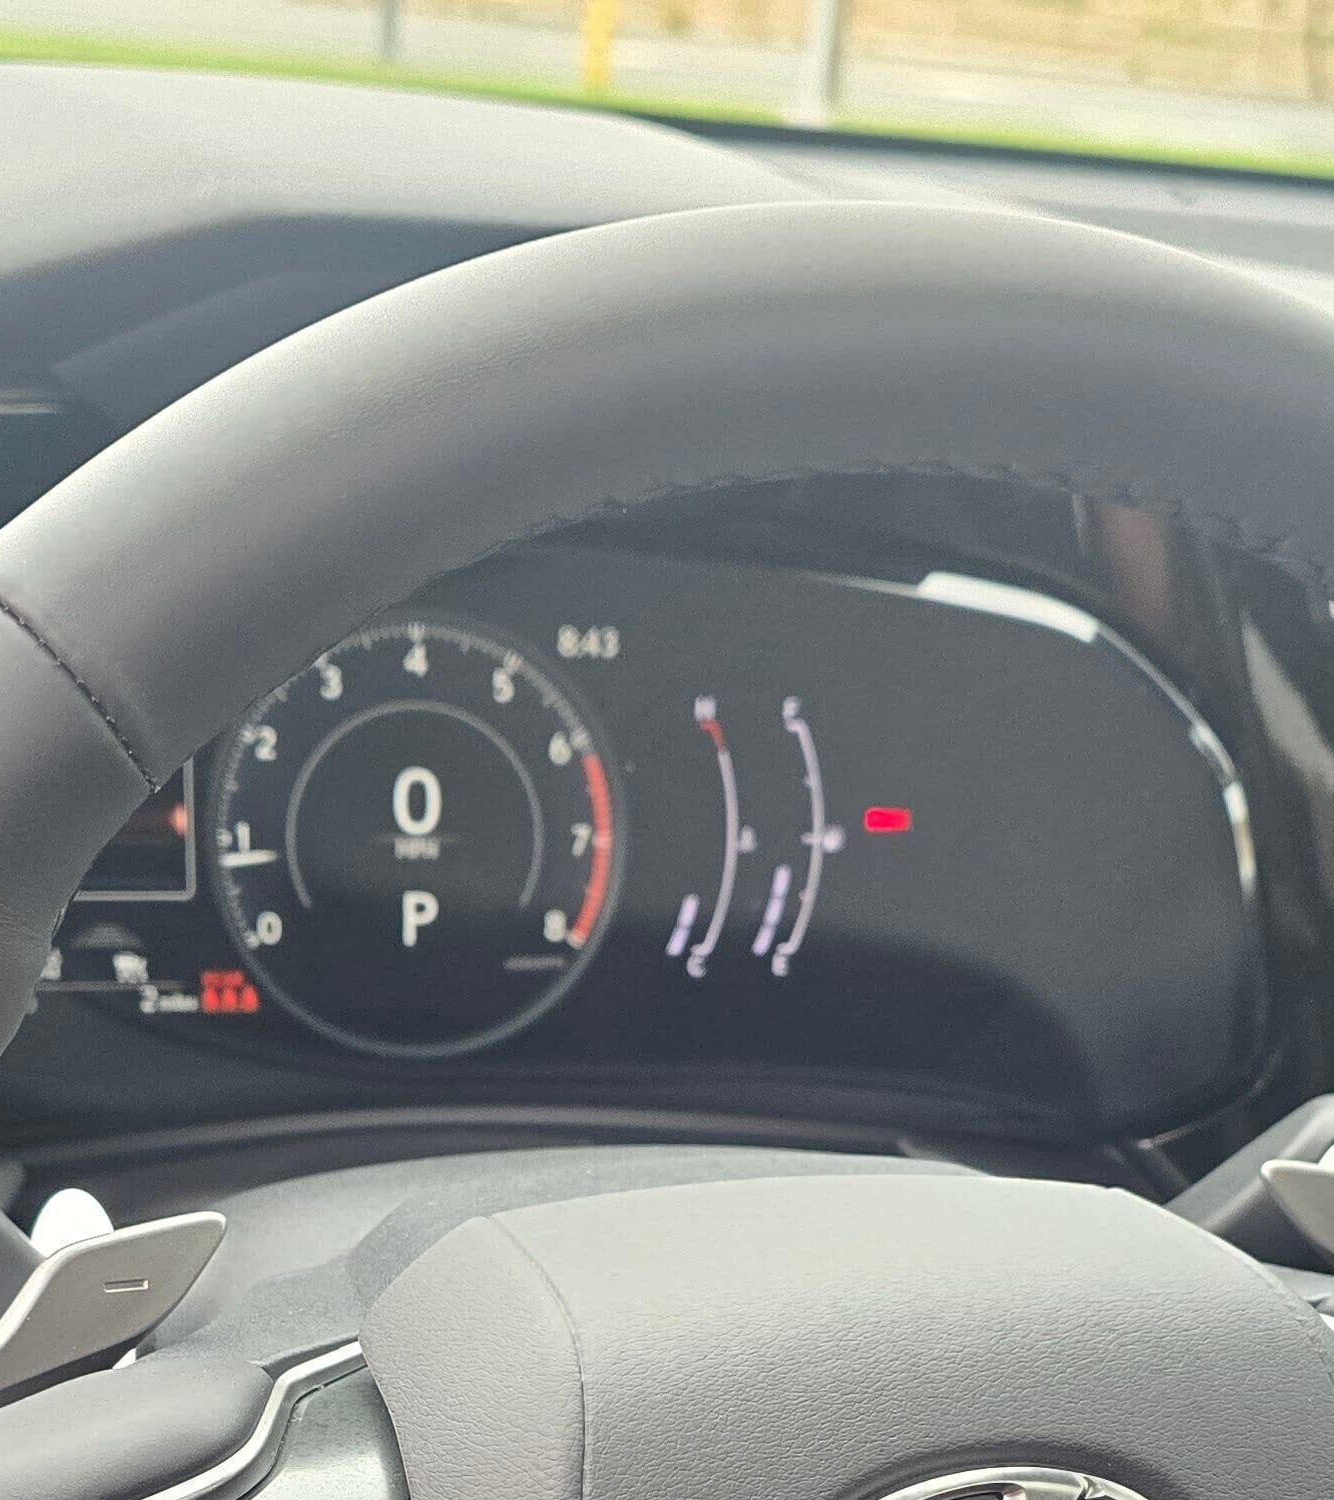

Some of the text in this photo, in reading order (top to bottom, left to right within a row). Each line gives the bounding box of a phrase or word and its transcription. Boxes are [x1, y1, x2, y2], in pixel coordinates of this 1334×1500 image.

[403, 644, 429, 677] 4
[318, 664, 343, 700] 3
[491, 666, 515, 703] 5
[254, 725, 278, 760] 2
[548, 731, 572, 765] 6
[392, 766, 443, 836] 0
[571, 822, 593, 857] 7
[257, 911, 283, 946] 0
[401, 891, 439, 947] P
[544, 909, 567, 943] 8
